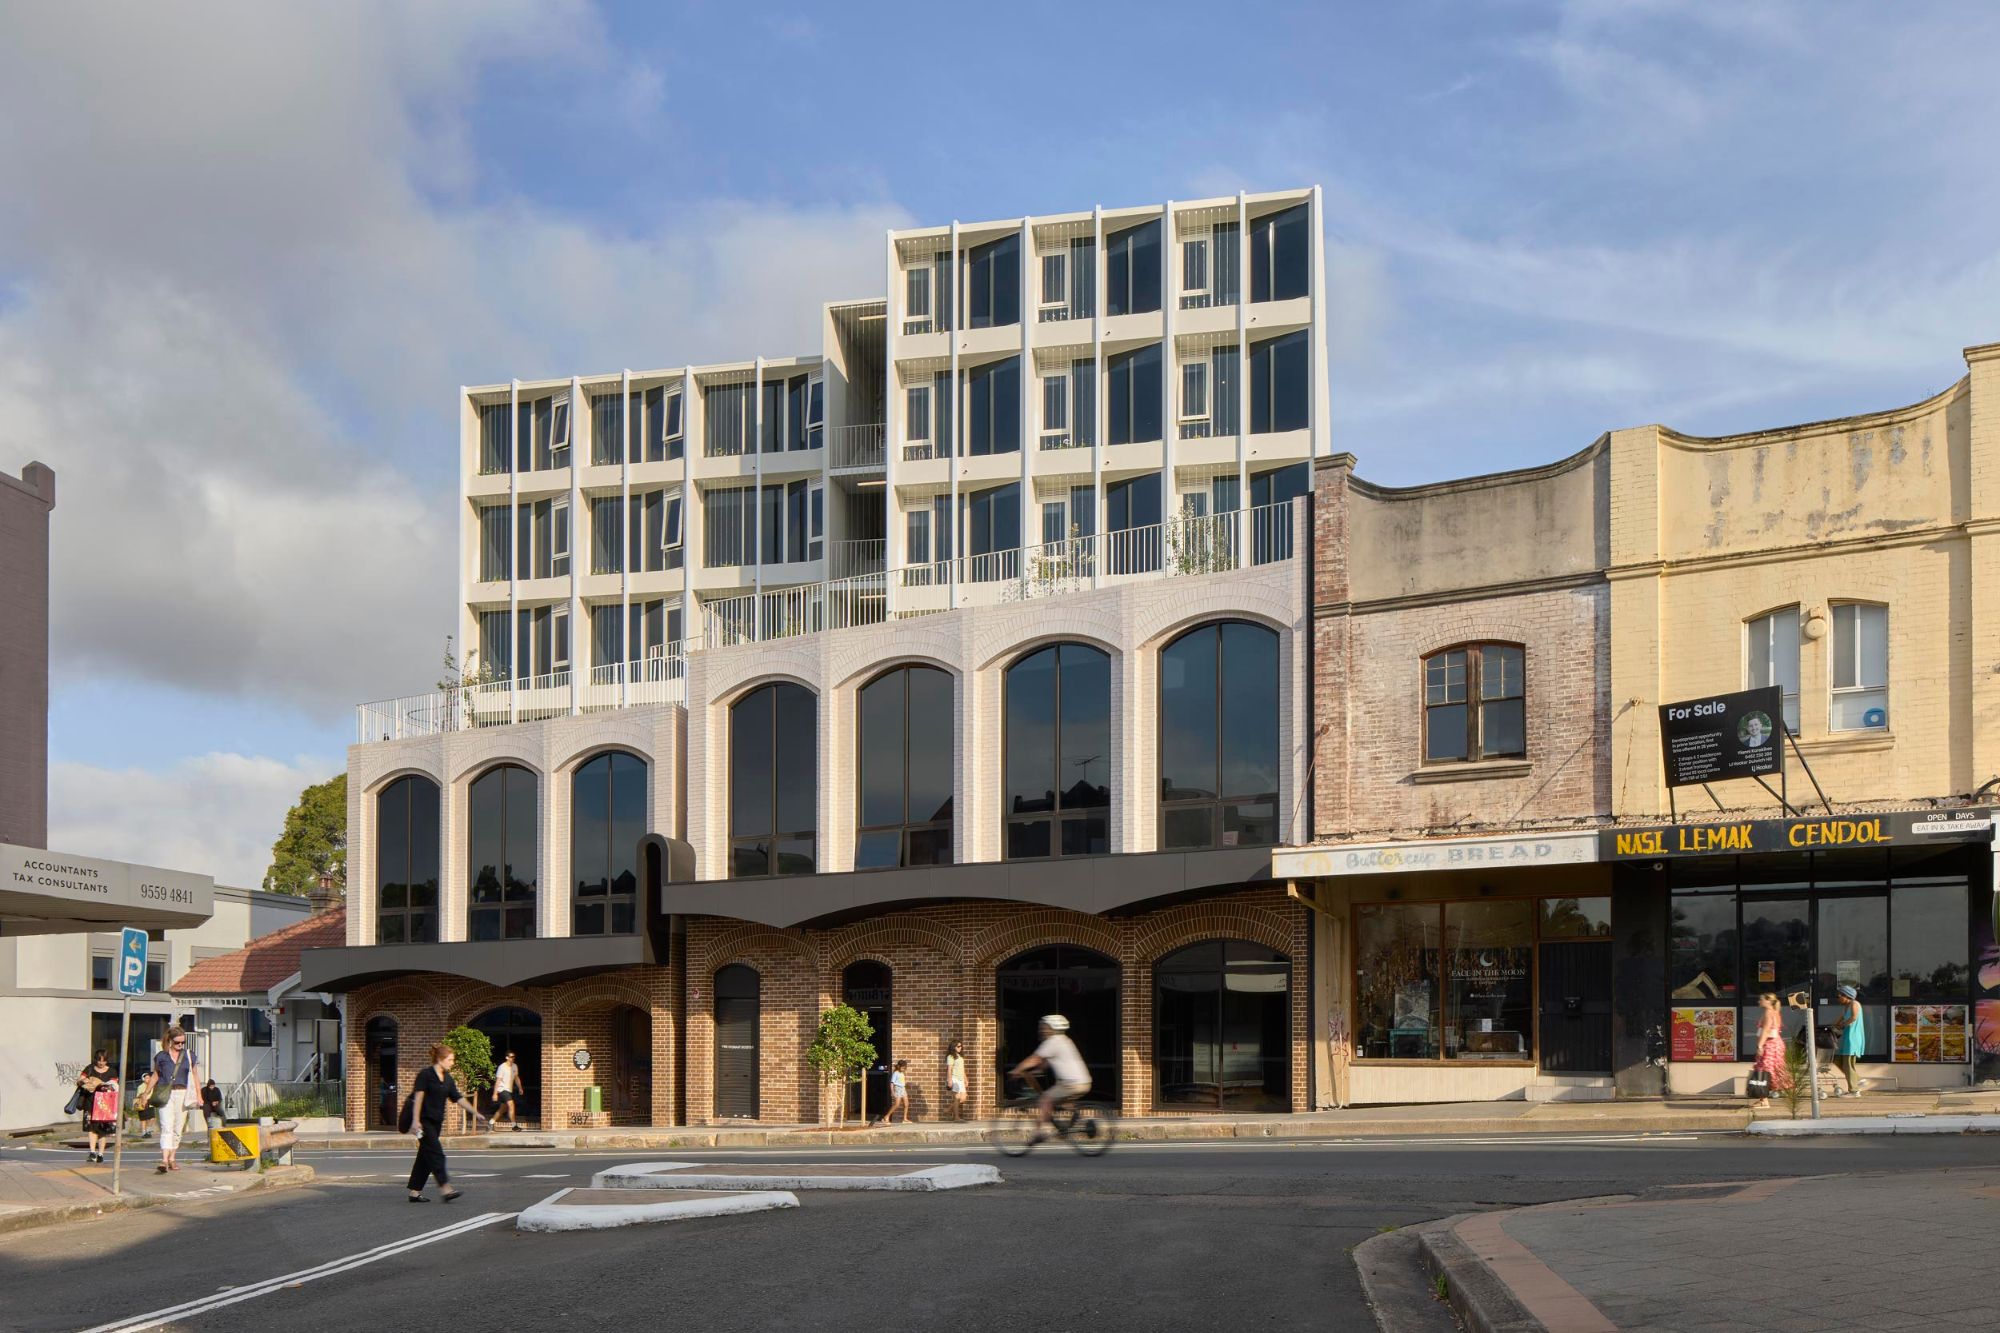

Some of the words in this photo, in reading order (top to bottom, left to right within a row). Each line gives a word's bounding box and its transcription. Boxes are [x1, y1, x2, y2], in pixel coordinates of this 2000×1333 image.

[1668, 707, 1692, 721] For
[1694, 701, 1726, 717] Sale
[1698, 732, 1722, 740] opportunity
[1927, 813, 1948, 821] OPEN
[1955, 812, 1975, 820] DAYS
[1917, 824, 1929, 832] EAT
[1947, 822, 1965, 830] TAKE
[1965, 821, 1986, 829] AWAY
[1616, 831, 1668, 855] NASI
[1679, 824, 1753, 851] LEMAK
[1788, 819, 1894, 847] CENDOL
[1447, 843, 1553, 863] BREAD
[24, 860, 99, 878] ACCOUNTANTS
[13, 872, 34, 883] TAX
[38, 877, 108, 893] CONSULTANTS
[141, 884, 167, 900] 9559
[169, 888, 193, 904] 4841
[124, 956, 142, 986] P
[1482, 969, 1499, 977] THE
[571, 1115, 589, 1125] 387
